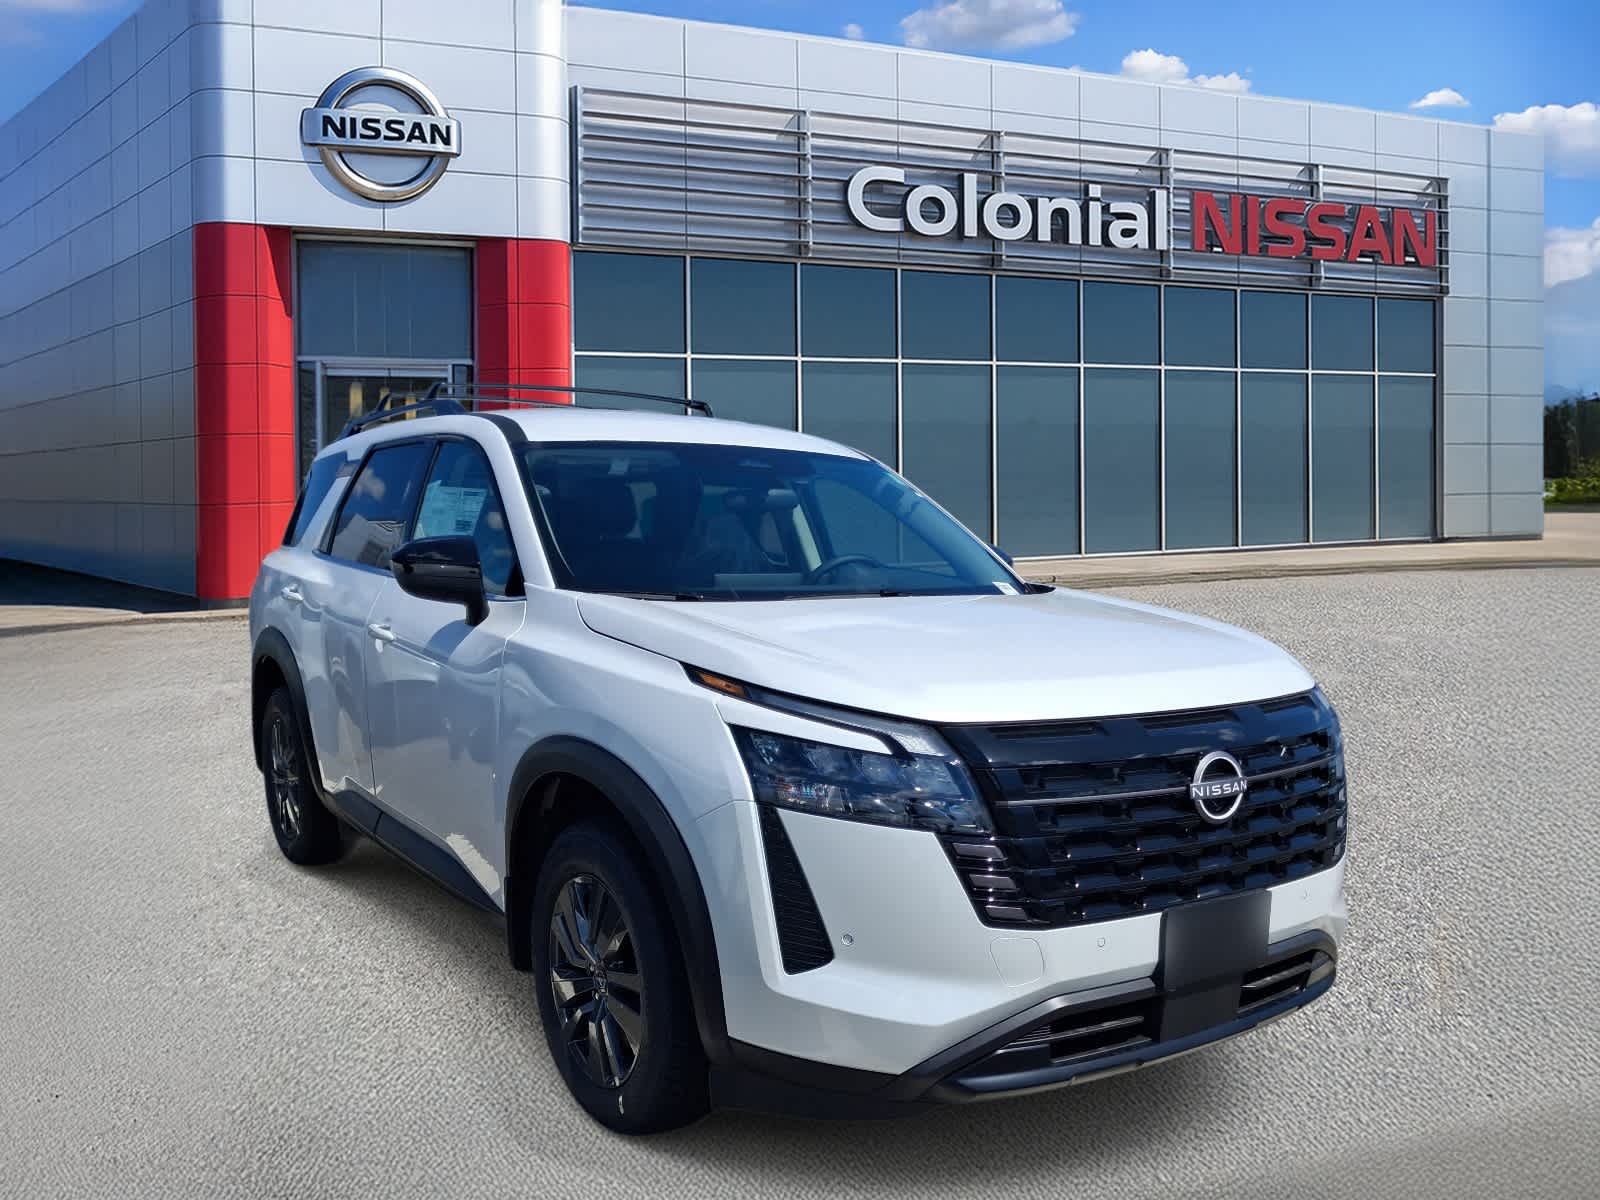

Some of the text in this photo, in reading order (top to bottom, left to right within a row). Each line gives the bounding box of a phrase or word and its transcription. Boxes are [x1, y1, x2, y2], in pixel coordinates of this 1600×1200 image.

[321, 115, 451, 146] NISSAN
[847, 166, 1437, 267] Colonial NISSAN
[1192, 780, 1247, 798] NISSAN
